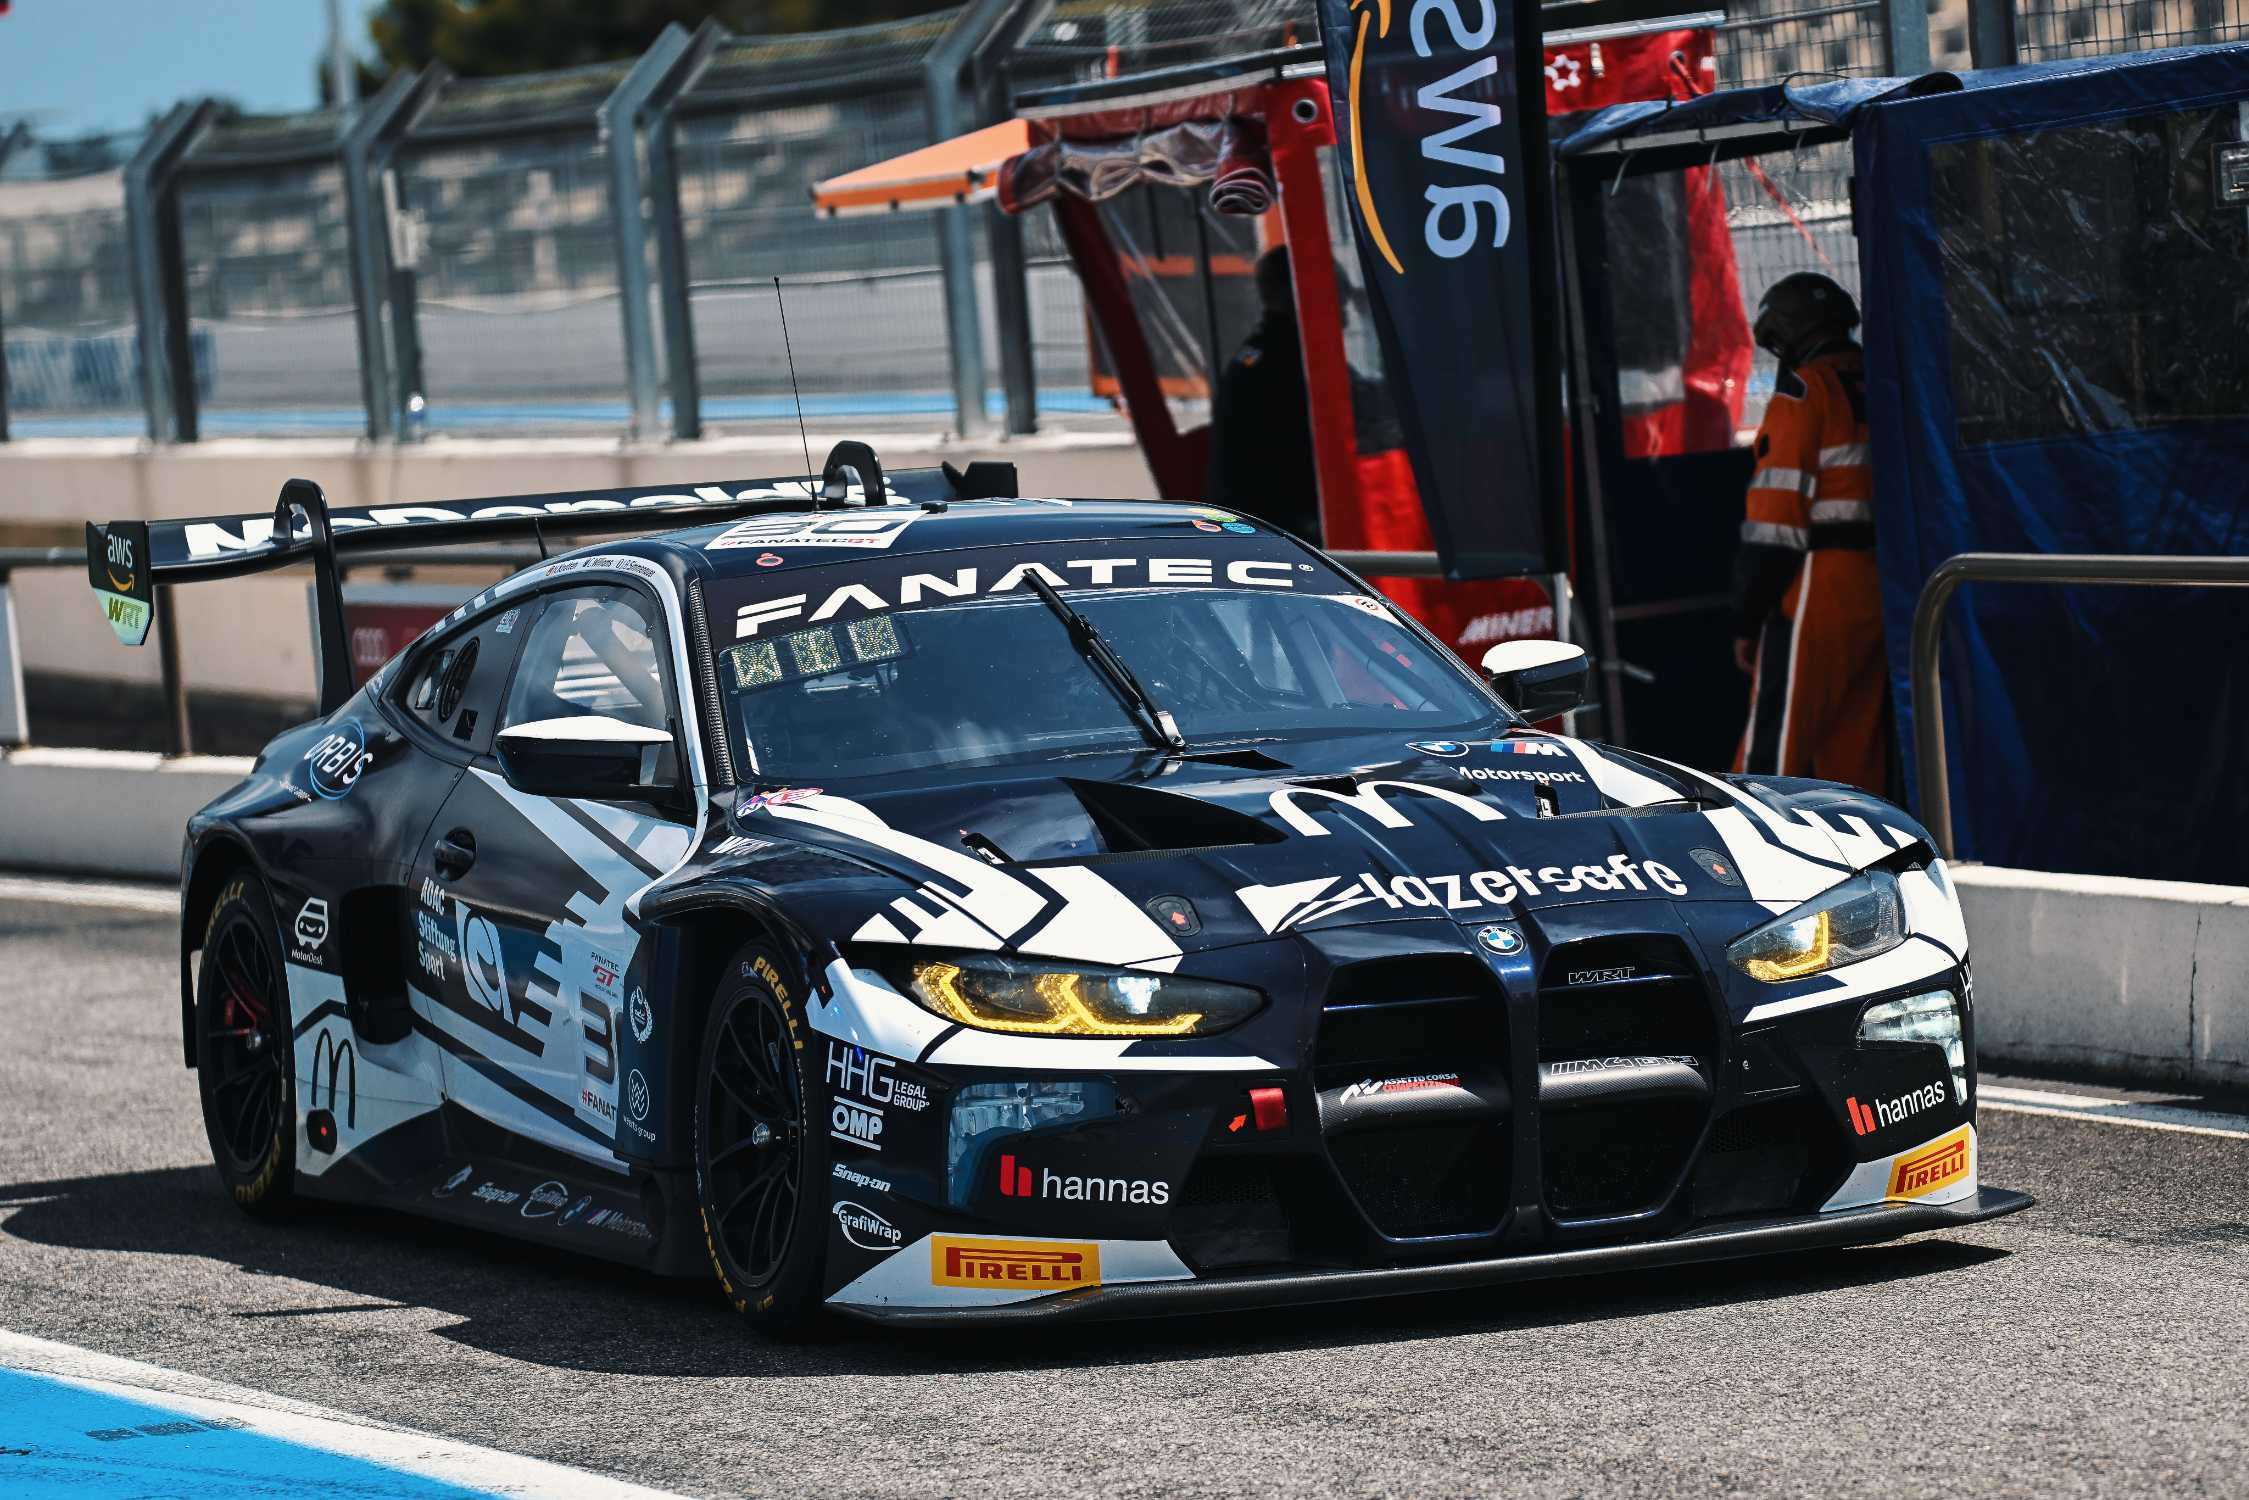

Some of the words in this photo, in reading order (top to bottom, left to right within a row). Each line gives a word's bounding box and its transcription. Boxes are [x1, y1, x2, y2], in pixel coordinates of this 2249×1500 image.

[107, 533, 133, 568] aws
[108, 597, 142, 629] WRT
[735, 558, 1294, 639] FANATEC
[303, 734, 373, 785] ORBIS
[1449, 766, 1586, 787] Motorsport
[420, 876, 445, 916] ADAC
[1358, 852, 1688, 910] lazersafe
[418, 911, 457, 963] Stiftung
[418, 940, 446, 982] Sport
[591, 951, 620, 972] FANATEC
[592, 964, 620, 986] GT
[1569, 966, 1636, 984] WRT
[752, 955, 804, 1050] PIRELLI
[826, 1041, 896, 1103] HHG
[894, 1080, 928, 1100] LEGAL
[1384, 1075, 1425, 1086] ASSETTO
[1427, 1073, 1459, 1082] CORSA
[1876, 1079, 1945, 1128] hannas
[832, 1105, 883, 1142] OMP
[832, 1163, 891, 1193] Snap-on
[1895, 1139, 1965, 1194] PIRELLI
[1042, 1167, 1170, 1205] hannas
[838, 1208, 902, 1244] GrafiWrap
[946, 1246, 1083, 1282] PIRELLI
